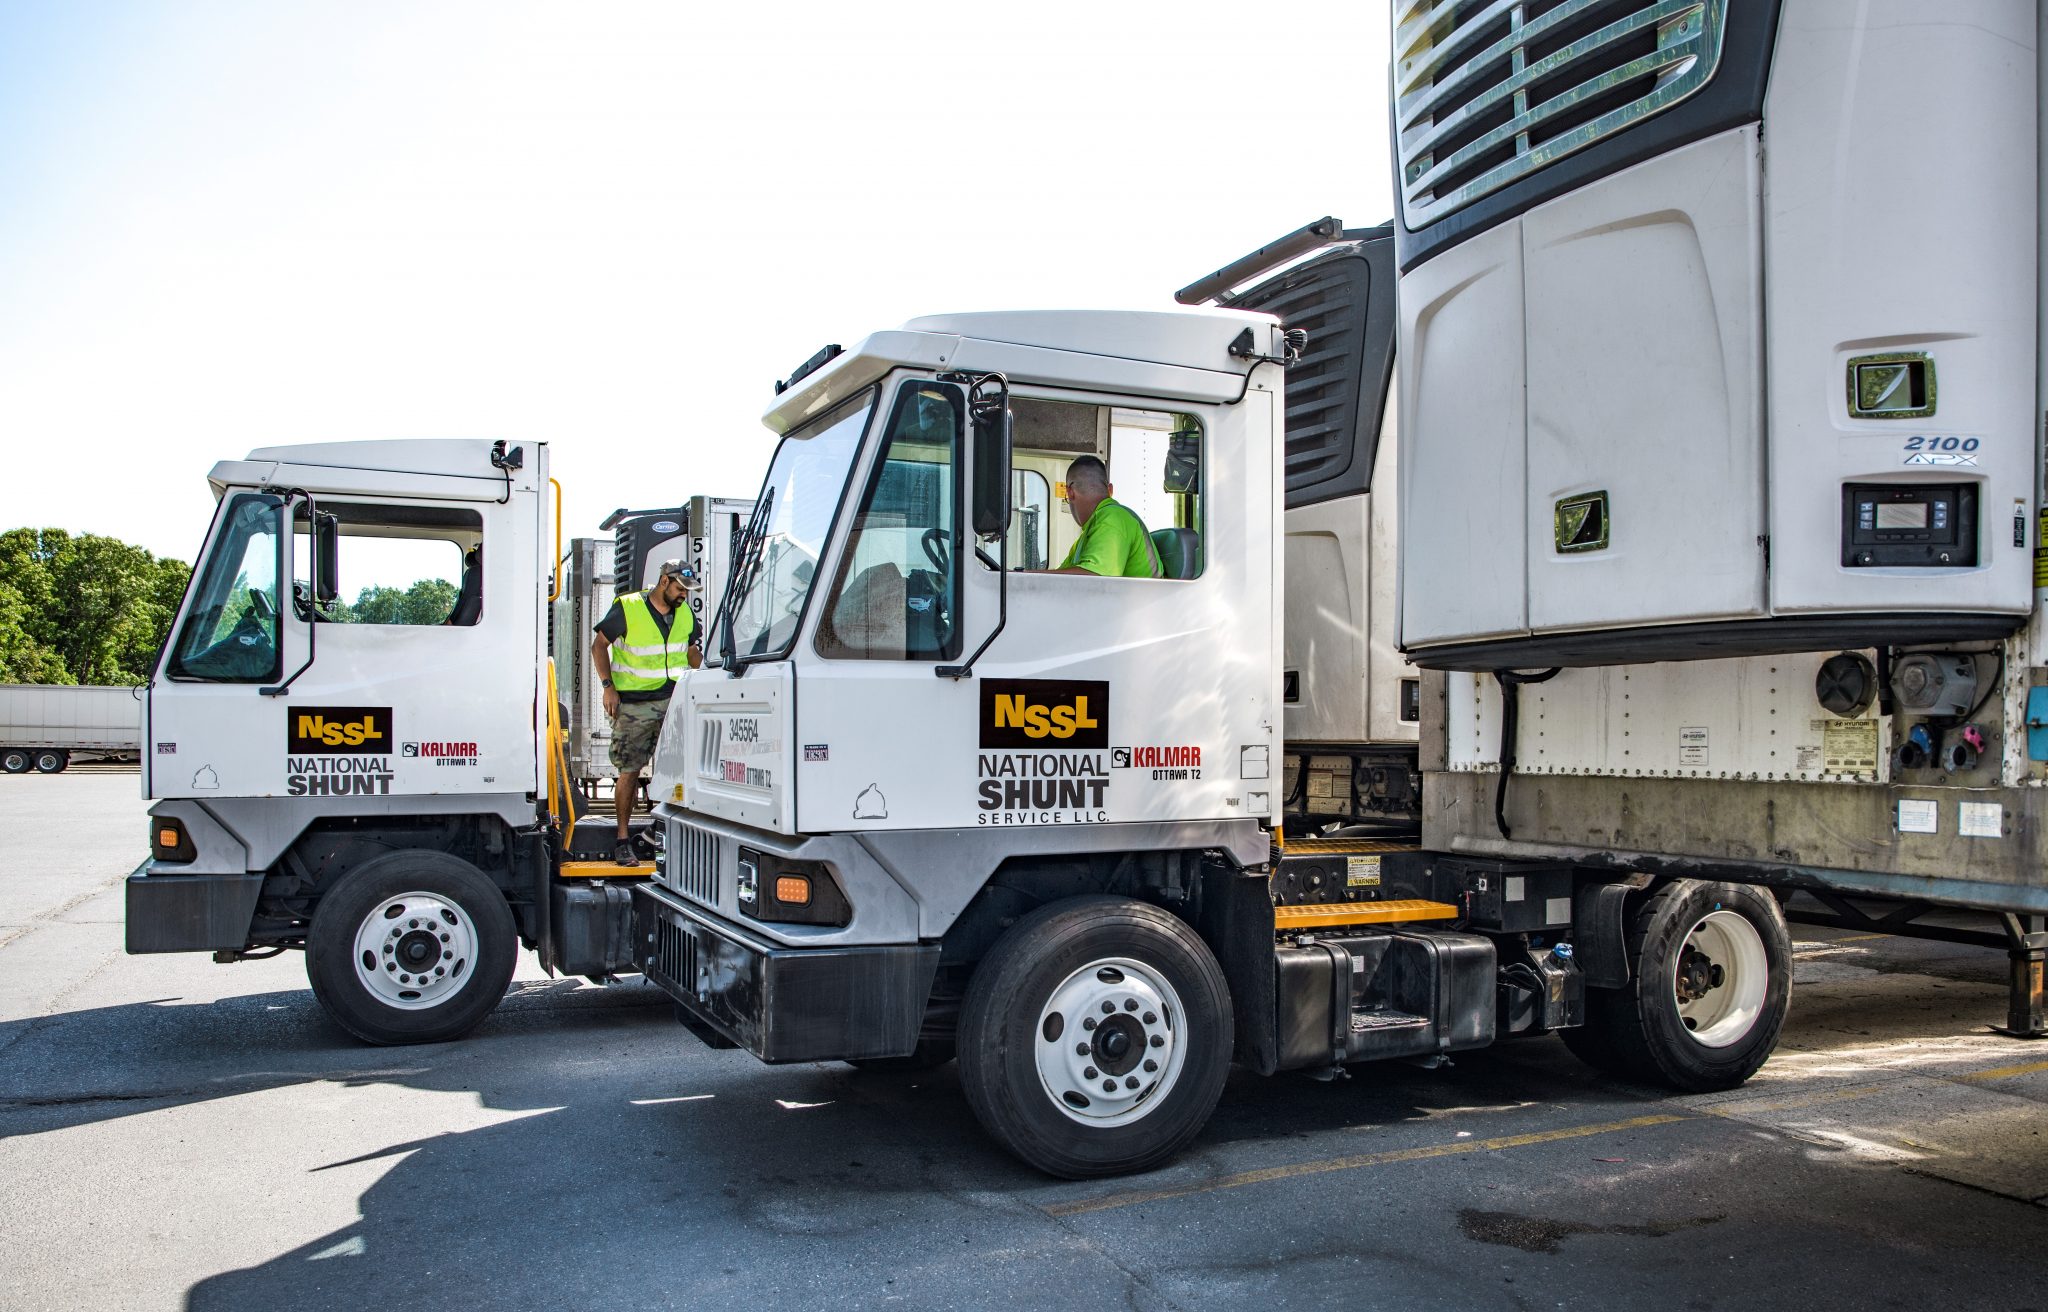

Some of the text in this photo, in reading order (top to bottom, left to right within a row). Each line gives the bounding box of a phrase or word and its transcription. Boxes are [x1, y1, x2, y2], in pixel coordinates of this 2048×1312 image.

[1904, 436, 1979, 452] 2100
[1903, 453, 1978, 467] APX
[729, 718, 758, 742] 345564
[421, 742, 477, 757] KALMAR
[1134, 746, 1201, 768] KALMAR
[288, 757, 394, 774] NATIONAL
[436, 758, 477, 767] OTTAWA T2
[979, 754, 1109, 777] NATIONAL
[726, 760, 746, 784] KALMAR
[1152, 769, 1201, 781] OTTAWA T2
[288, 774, 394, 795] SHUNT
[978, 779, 1110, 810] SHUNT
[978, 810, 1110, 825] SERVICE LLC.
